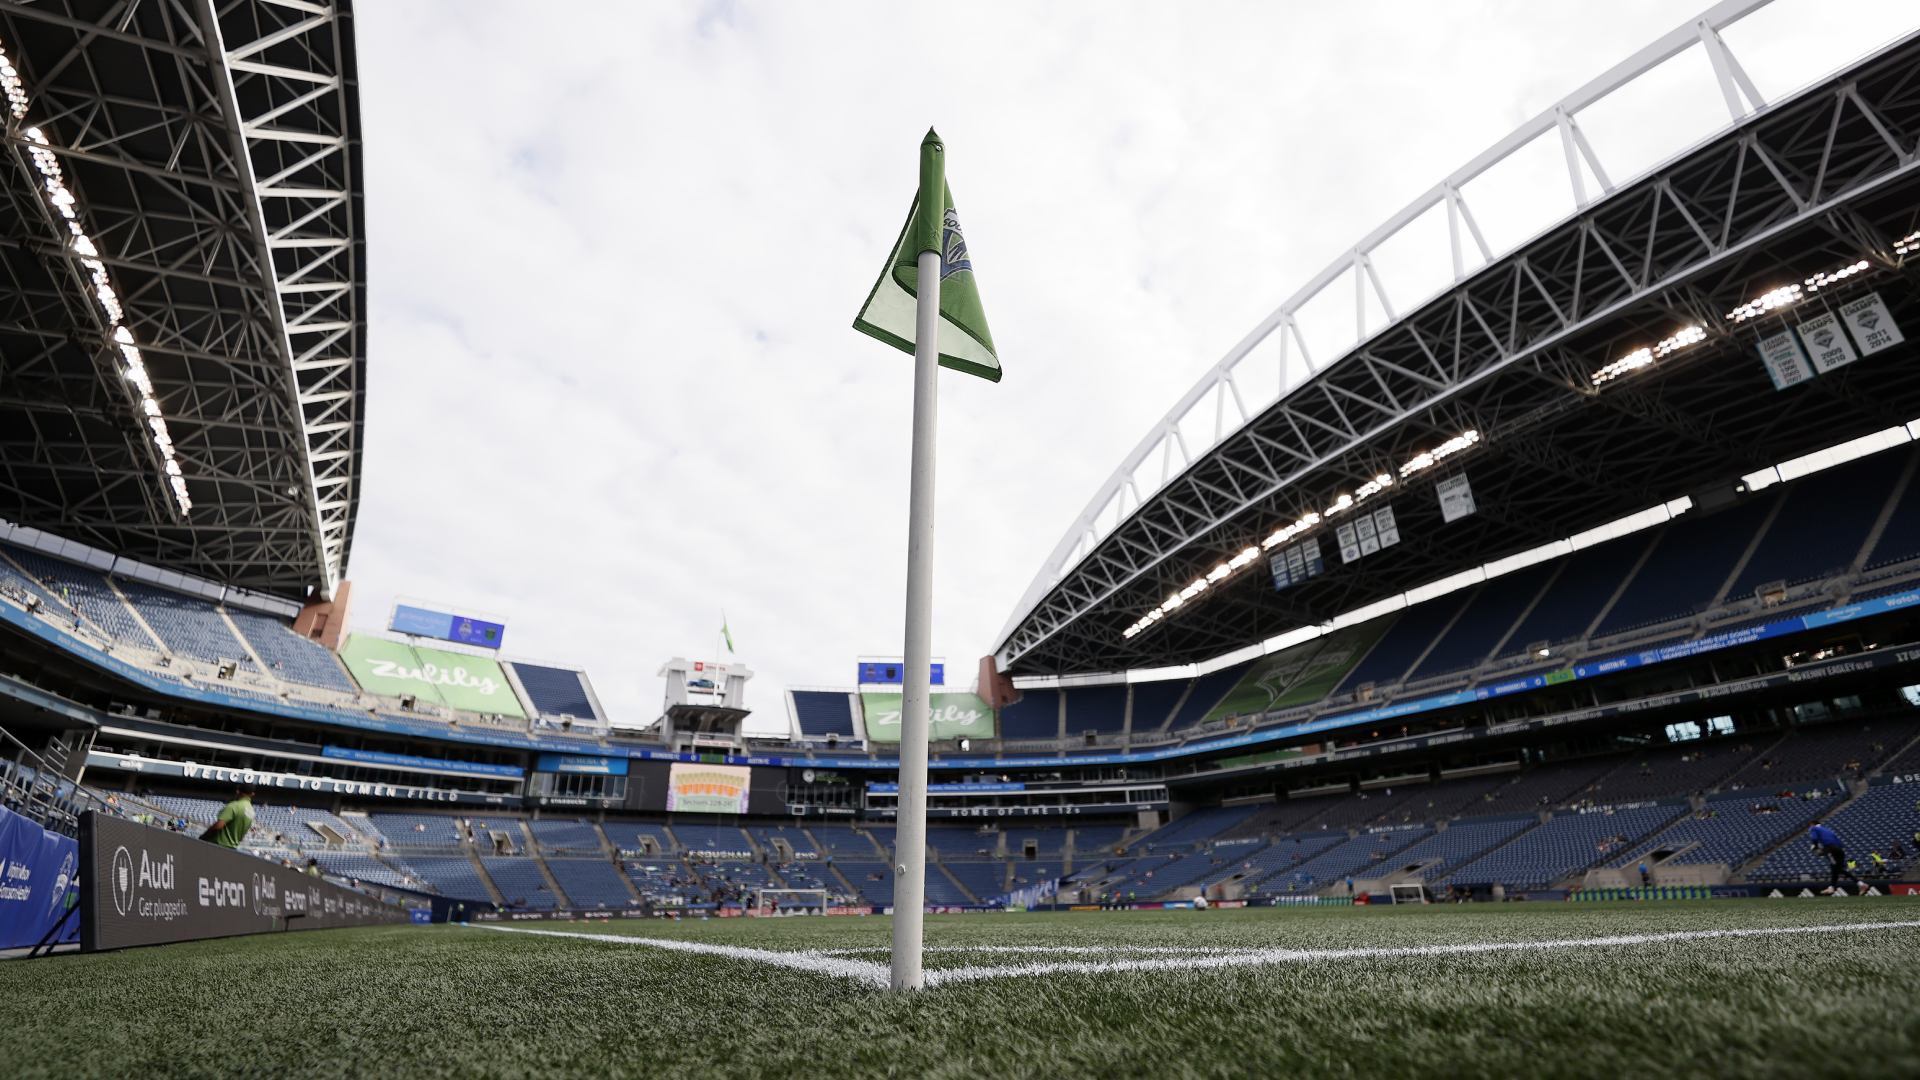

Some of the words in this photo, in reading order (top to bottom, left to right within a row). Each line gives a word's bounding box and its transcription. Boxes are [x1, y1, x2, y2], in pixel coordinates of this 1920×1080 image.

[1865, 329, 1888, 342] 2011
[1870, 335, 1892, 348] 2014
[183, 764, 286, 787] WELCOME
[299, 778, 322, 791] TO
[333, 782, 397, 798] LUMEN
[407, 788, 459, 802] FIELD
[951, 809, 989, 817] HOME
[999, 808, 1014, 816] OF
[1024, 807, 1049, 815] THE
[138, 849, 175, 890] Audi
[198, 877, 246, 908] e-tron
[261, 873, 276, 900] Audi
[139, 897, 153, 917] Get
[153, 898, 180, 921] plugged
[284, 889, 307, 911] e-tron
